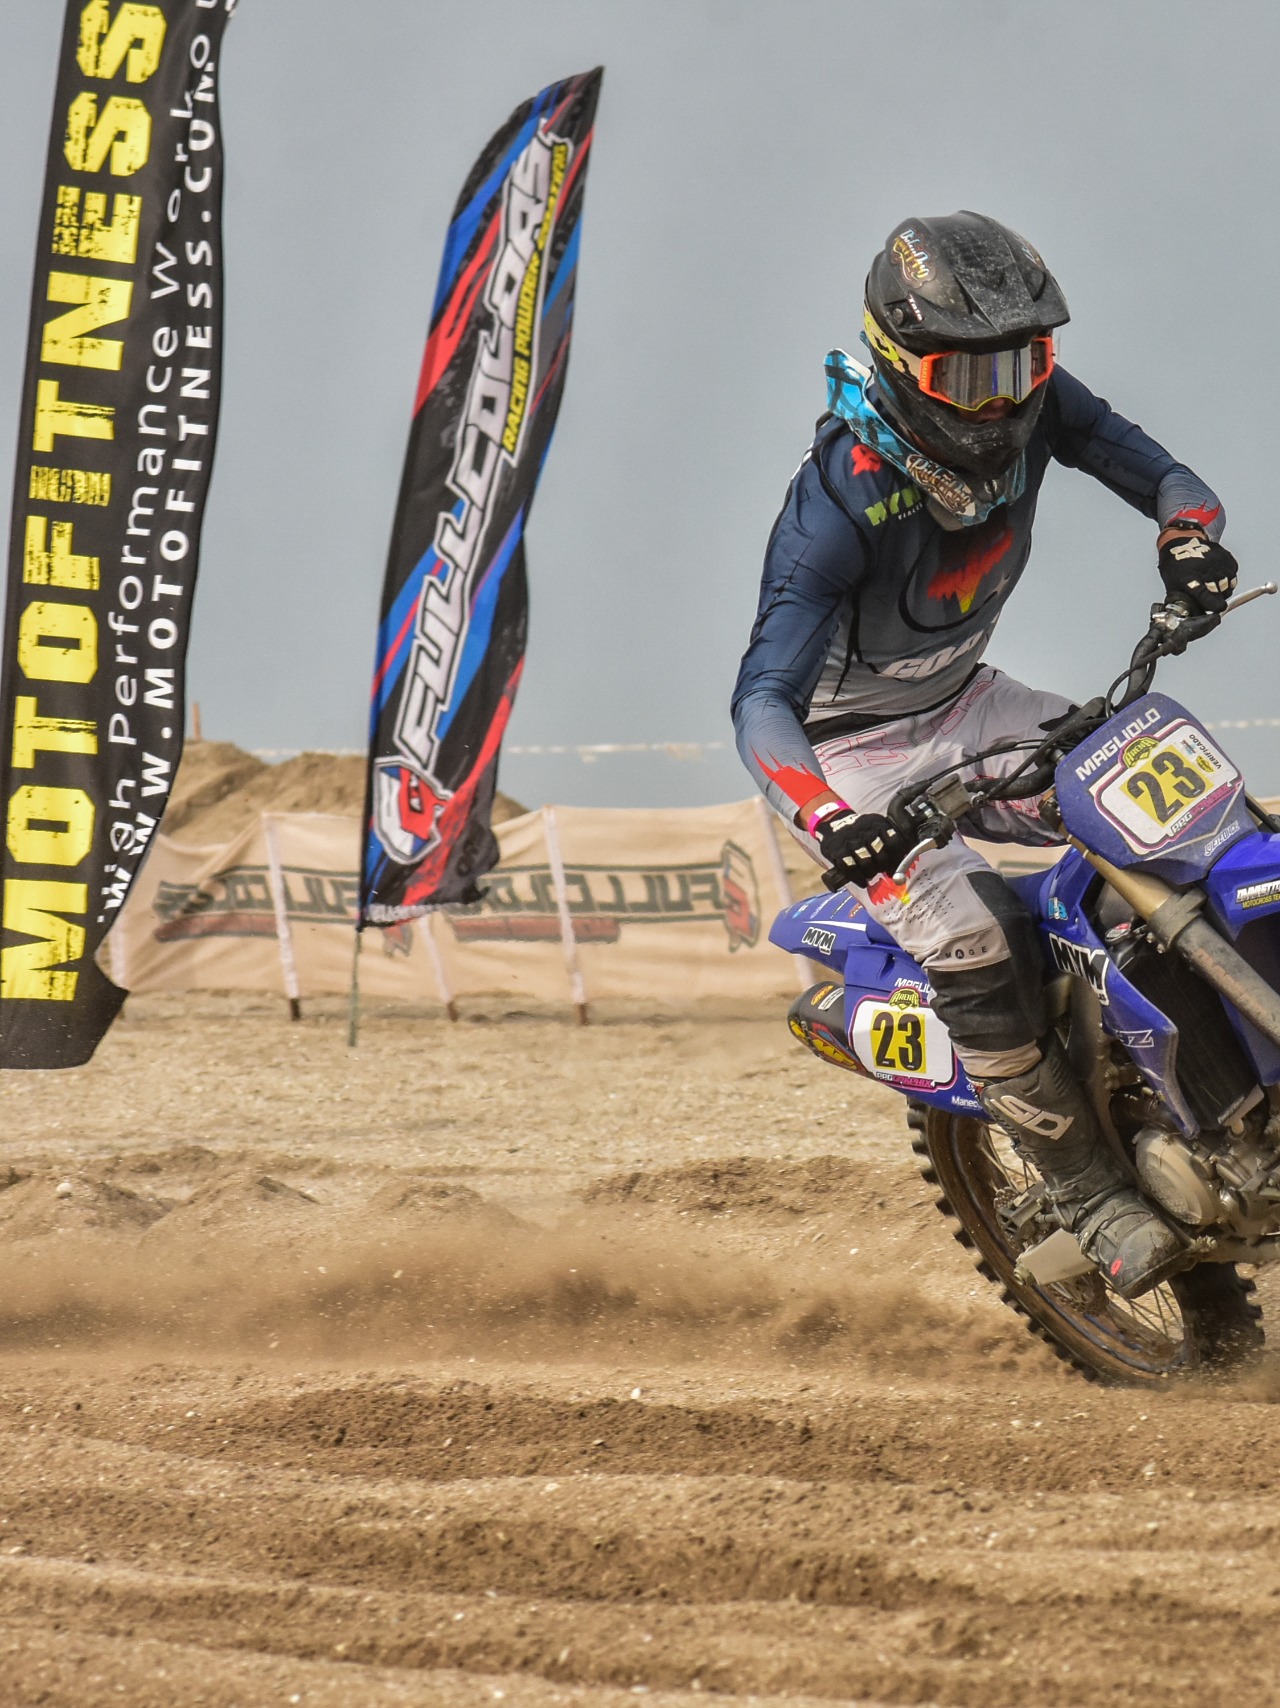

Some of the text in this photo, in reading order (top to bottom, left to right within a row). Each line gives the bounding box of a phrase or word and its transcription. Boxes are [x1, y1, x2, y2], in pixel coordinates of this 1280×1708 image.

[501, 355, 532, 453] RACING
[0, 0, 167, 1001] MOTOFITNESS
[109, 326, 179, 745] Performance
[1075, 707, 1162, 782] MAGLIOLO
[1189, 734, 1223, 769] VERIFICADO
[1126, 750, 1207, 825] 23
[803, 927, 836, 951] MYM
[1242, 895, 1273, 910] MOTOCROSS
[873, 1011, 923, 1072] 23
